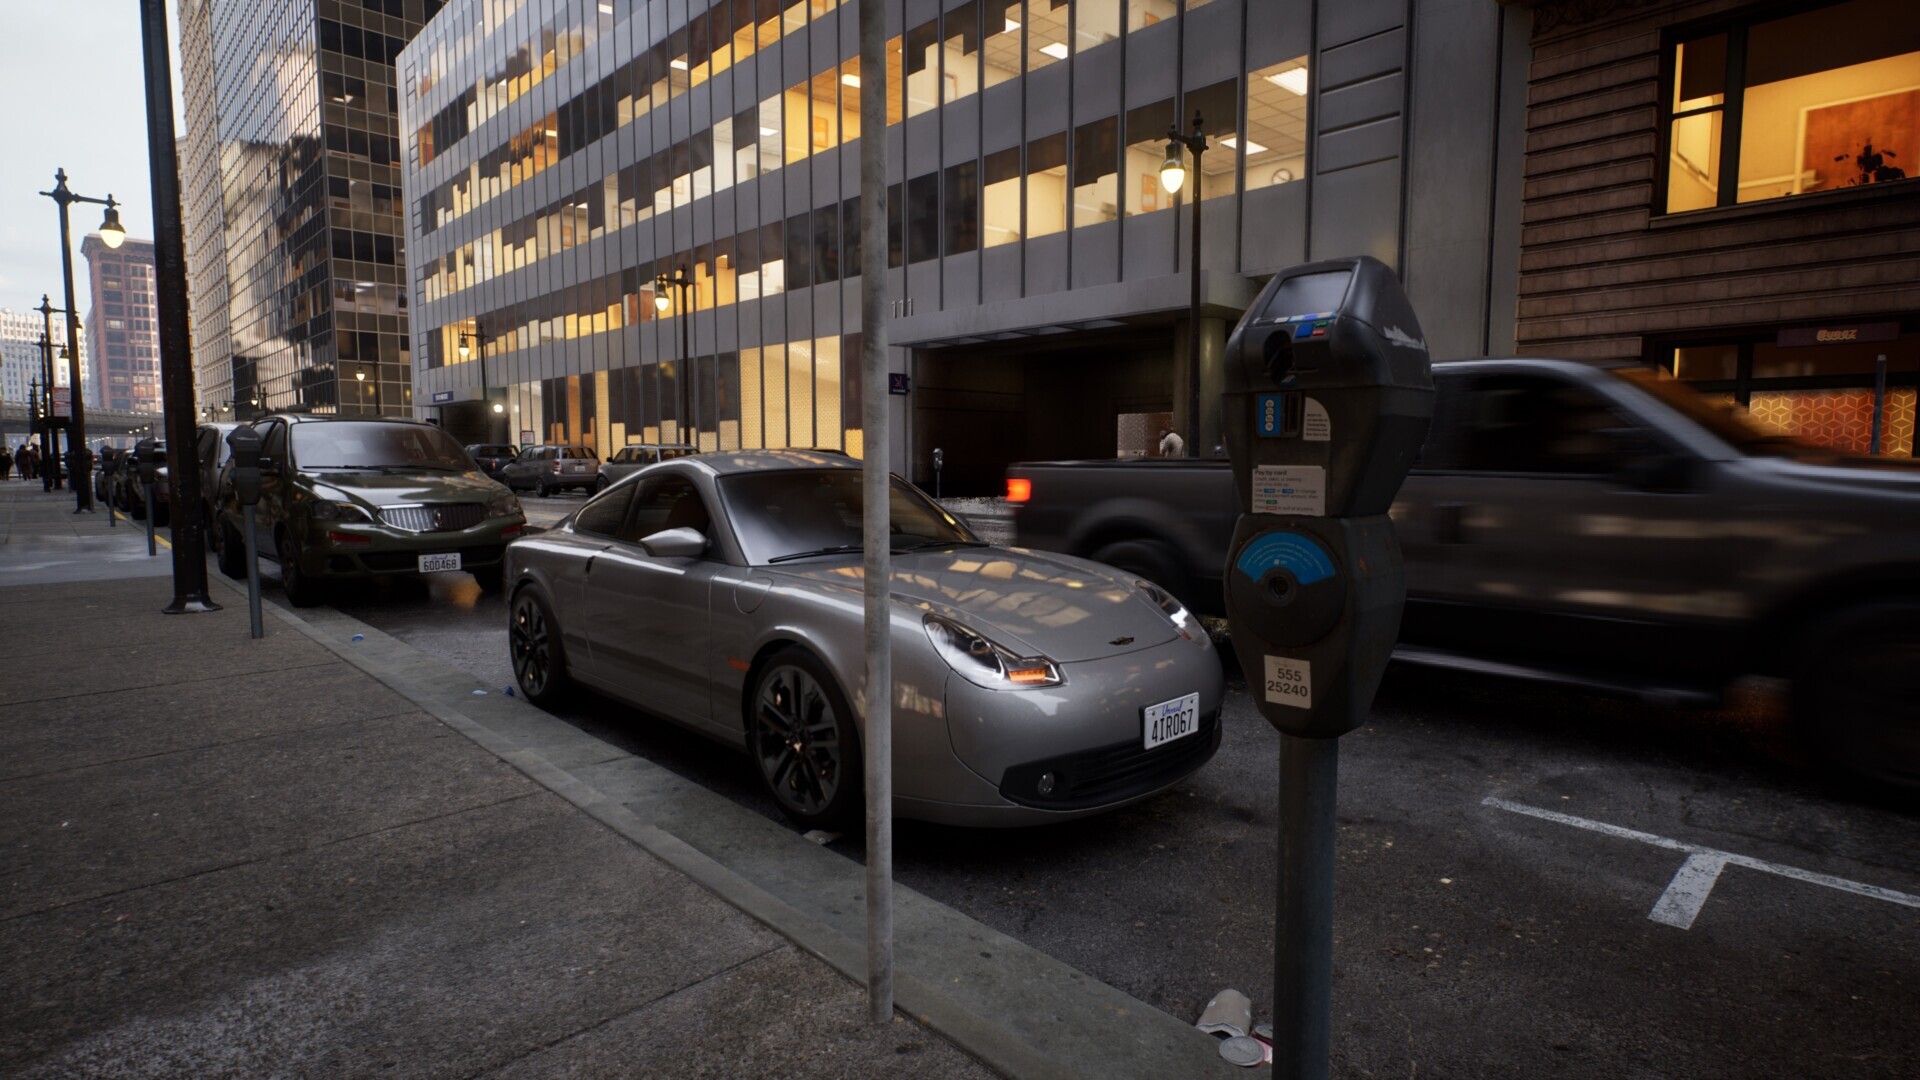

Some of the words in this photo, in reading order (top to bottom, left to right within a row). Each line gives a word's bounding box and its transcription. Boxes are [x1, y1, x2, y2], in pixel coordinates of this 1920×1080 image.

[892, 298, 913, 318] 111
[1277, 668, 1302, 682] 555
[1267, 680, 1308, 697] 25240
